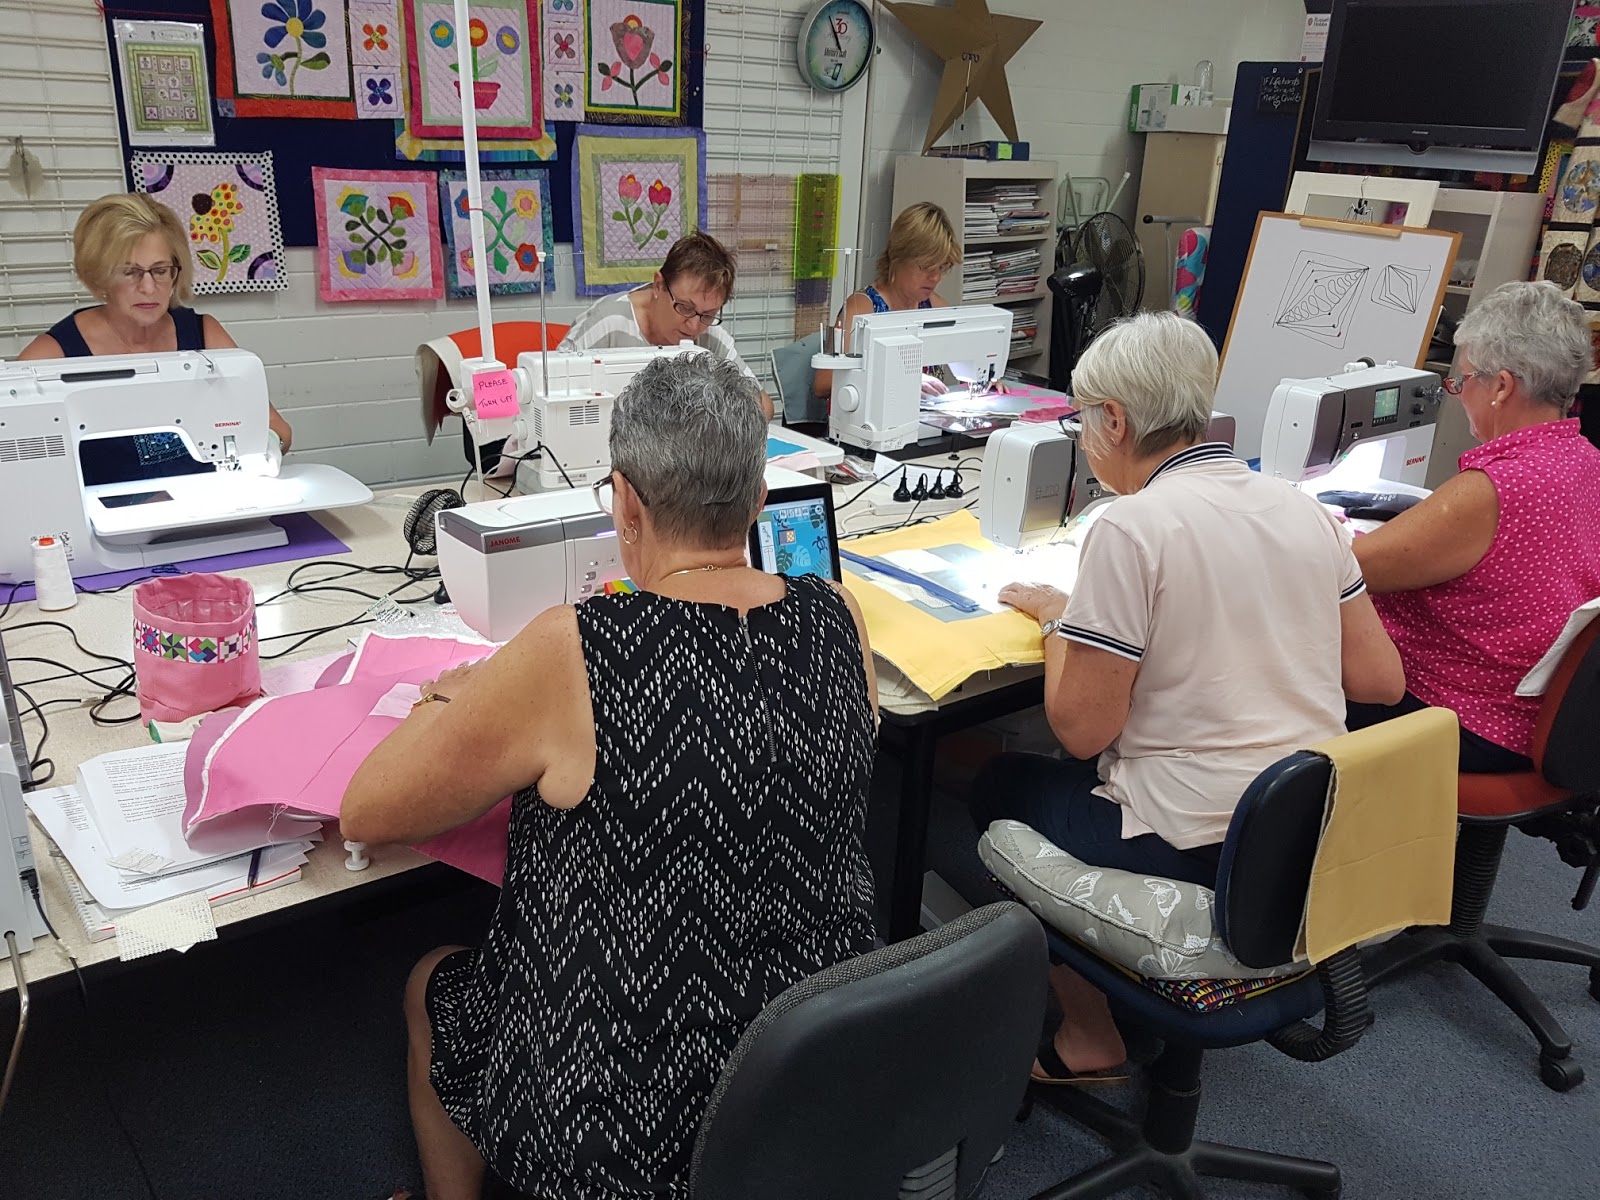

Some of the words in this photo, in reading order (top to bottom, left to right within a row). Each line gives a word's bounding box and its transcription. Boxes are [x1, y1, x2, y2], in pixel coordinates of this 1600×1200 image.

[835, 18, 848, 35] 30
[478, 379, 509, 390] PLEASE
[490, 536, 521, 548] JANOME
